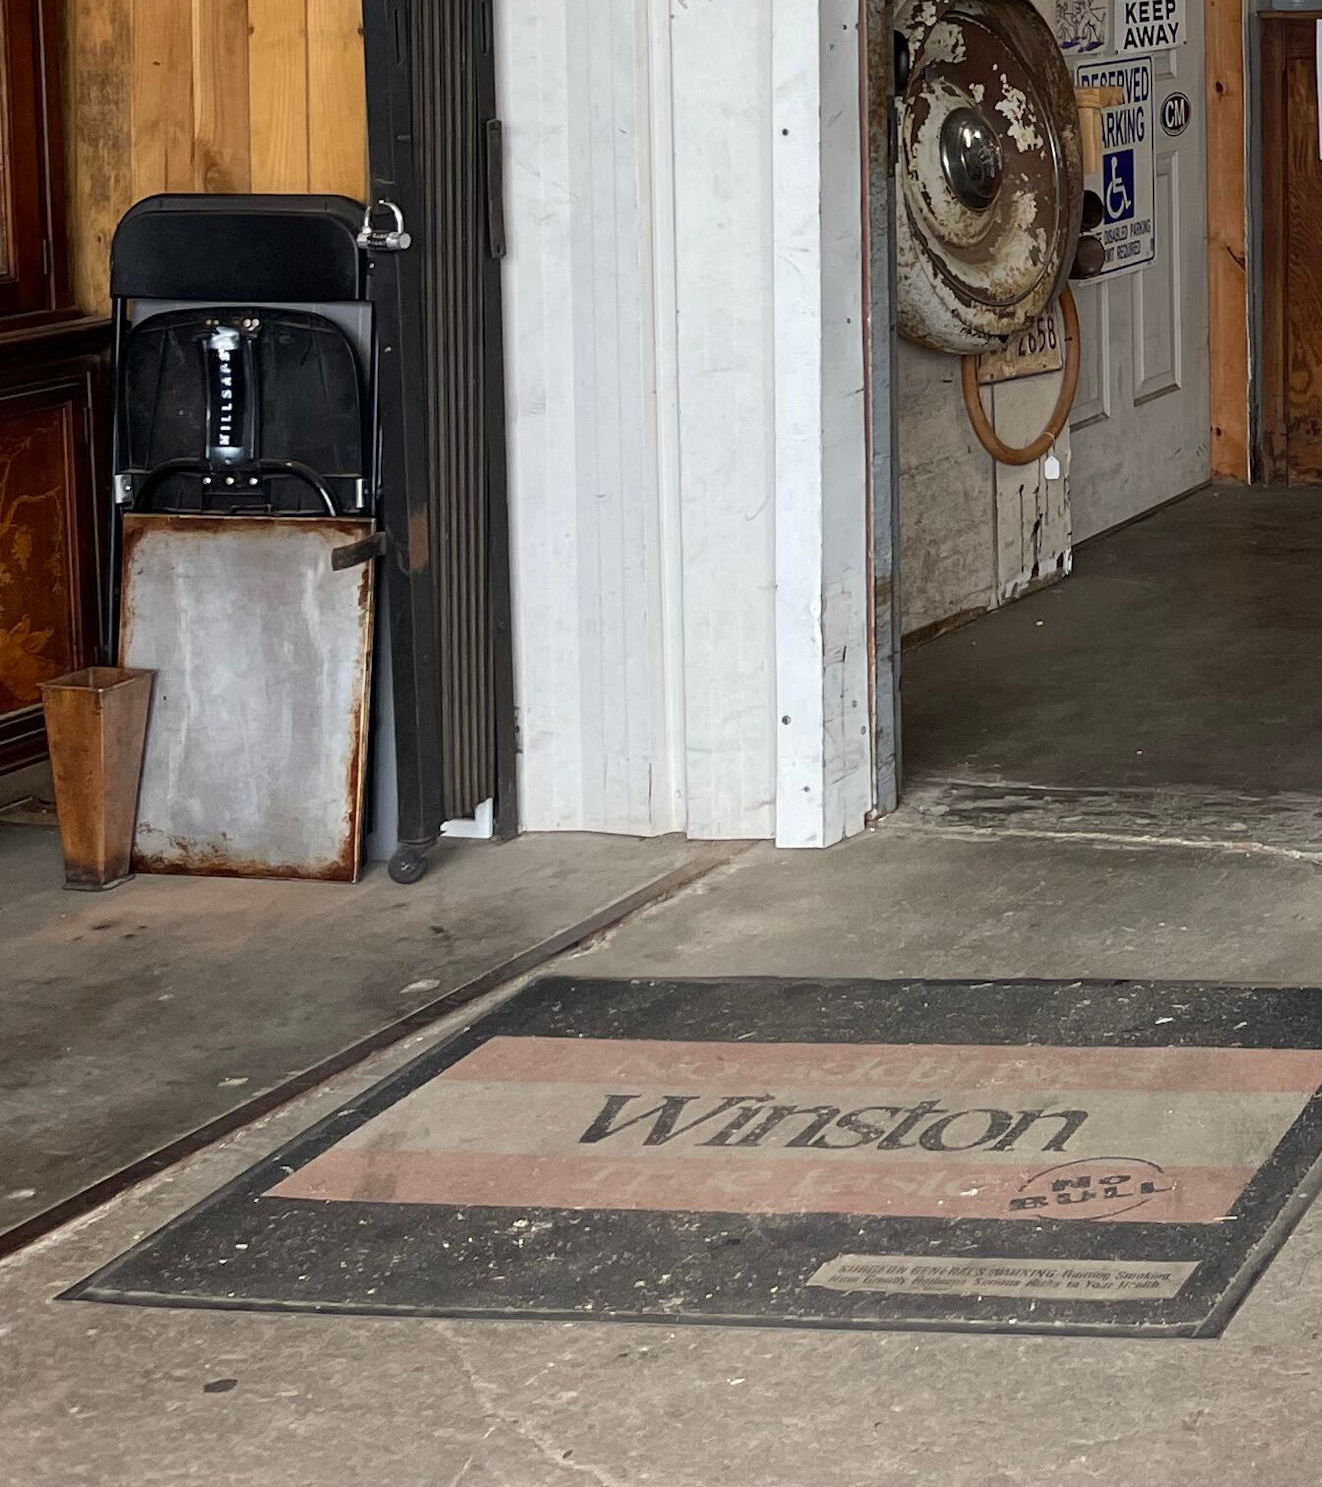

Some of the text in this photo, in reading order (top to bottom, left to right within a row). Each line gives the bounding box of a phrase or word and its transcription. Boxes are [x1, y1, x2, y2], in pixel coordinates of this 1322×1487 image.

[1123, 22, 1179, 49] AWAY
[1165, 98, 1186, 128] CM
[578, 1092, 1090, 1153] Winston
[1008, 1178, 1180, 1212] BULL
[839, 1265, 907, 1275] SURGEON
[1086, 1280, 1113, 1289] Your
